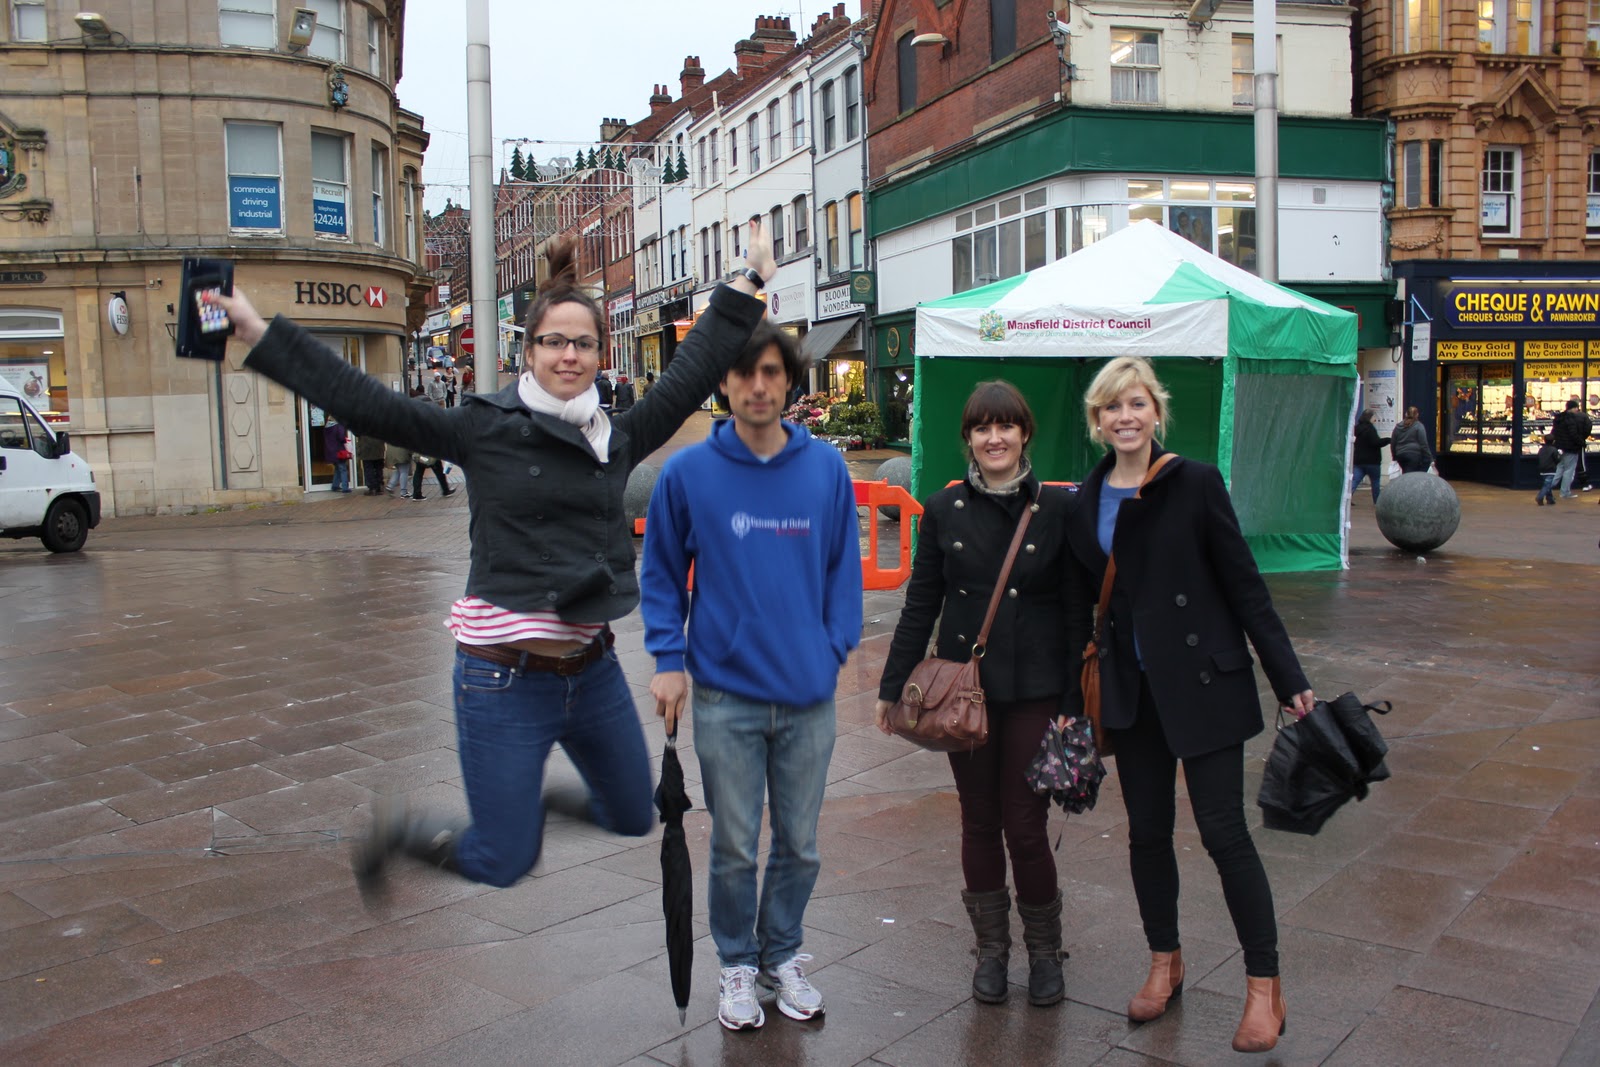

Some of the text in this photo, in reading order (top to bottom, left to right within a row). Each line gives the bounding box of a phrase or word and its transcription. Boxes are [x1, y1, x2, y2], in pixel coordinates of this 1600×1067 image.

[233, 186, 276, 194] commercial
[320, 187, 343, 197] Recruit
[242, 197, 269, 208] driving
[238, 209, 273, 218] industrial
[317, 205, 338, 213] telephone
[313, 212, 344, 227] 424244
[11, 273, 40, 281] PLACE
[294, 281, 362, 306] HSBC
[825, 287, 851, 302] BLOOMI
[1455, 292, 1599, 322] CHEQUE & PAWN
[1458, 313, 1524, 322] CHEQUES CASHED
[1550, 313, 1596, 322] PAWNBROKER
[1007, 318, 1151, 330] Mansfield District Council
[1462, 343, 1482, 351] Buy
[1528, 342, 1579, 351] We Buy Gold
[1525, 350, 1541, 358] Any
[1589, 349, 1600, 357] An
